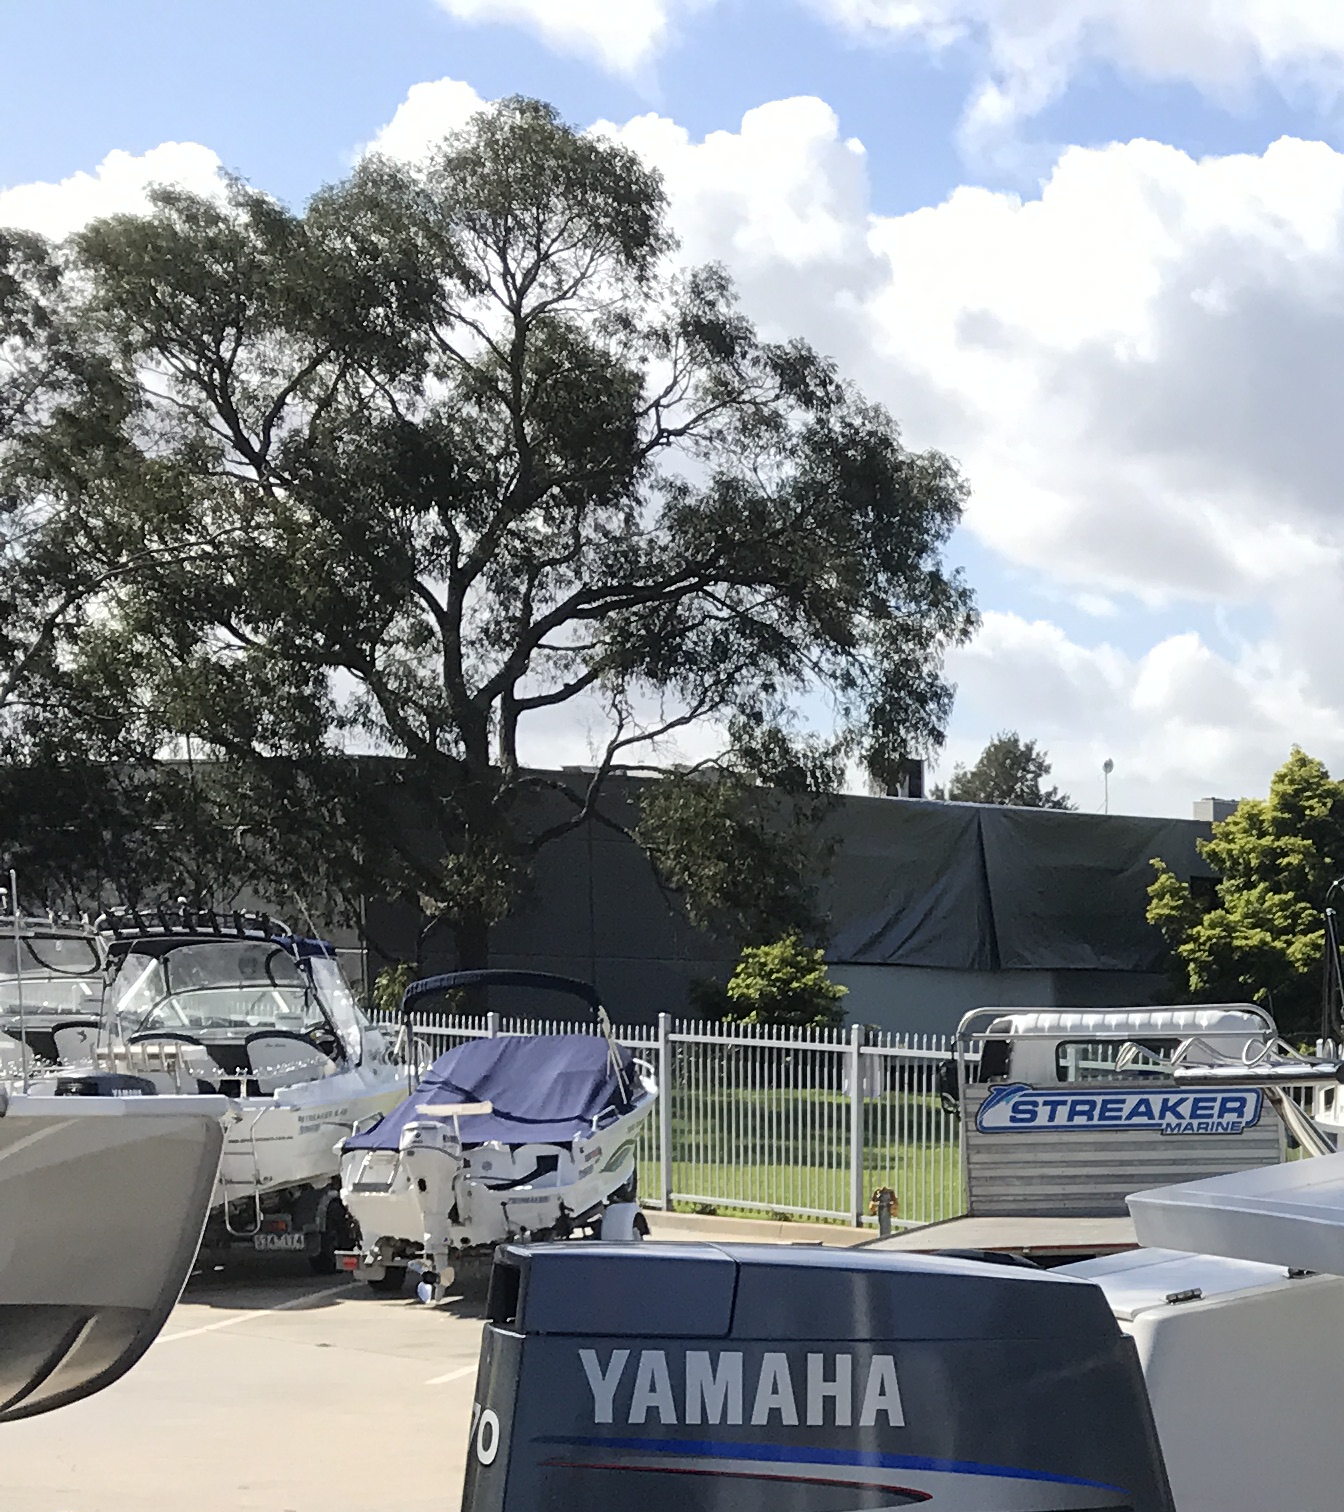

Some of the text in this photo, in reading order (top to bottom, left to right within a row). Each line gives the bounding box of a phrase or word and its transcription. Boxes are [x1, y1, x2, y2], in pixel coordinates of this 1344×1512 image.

[1009, 1096, 1248, 1124] STREAKER
[1165, 1121, 1243, 1134] MARINE
[578, 1349, 906, 1427] YAMAHA
